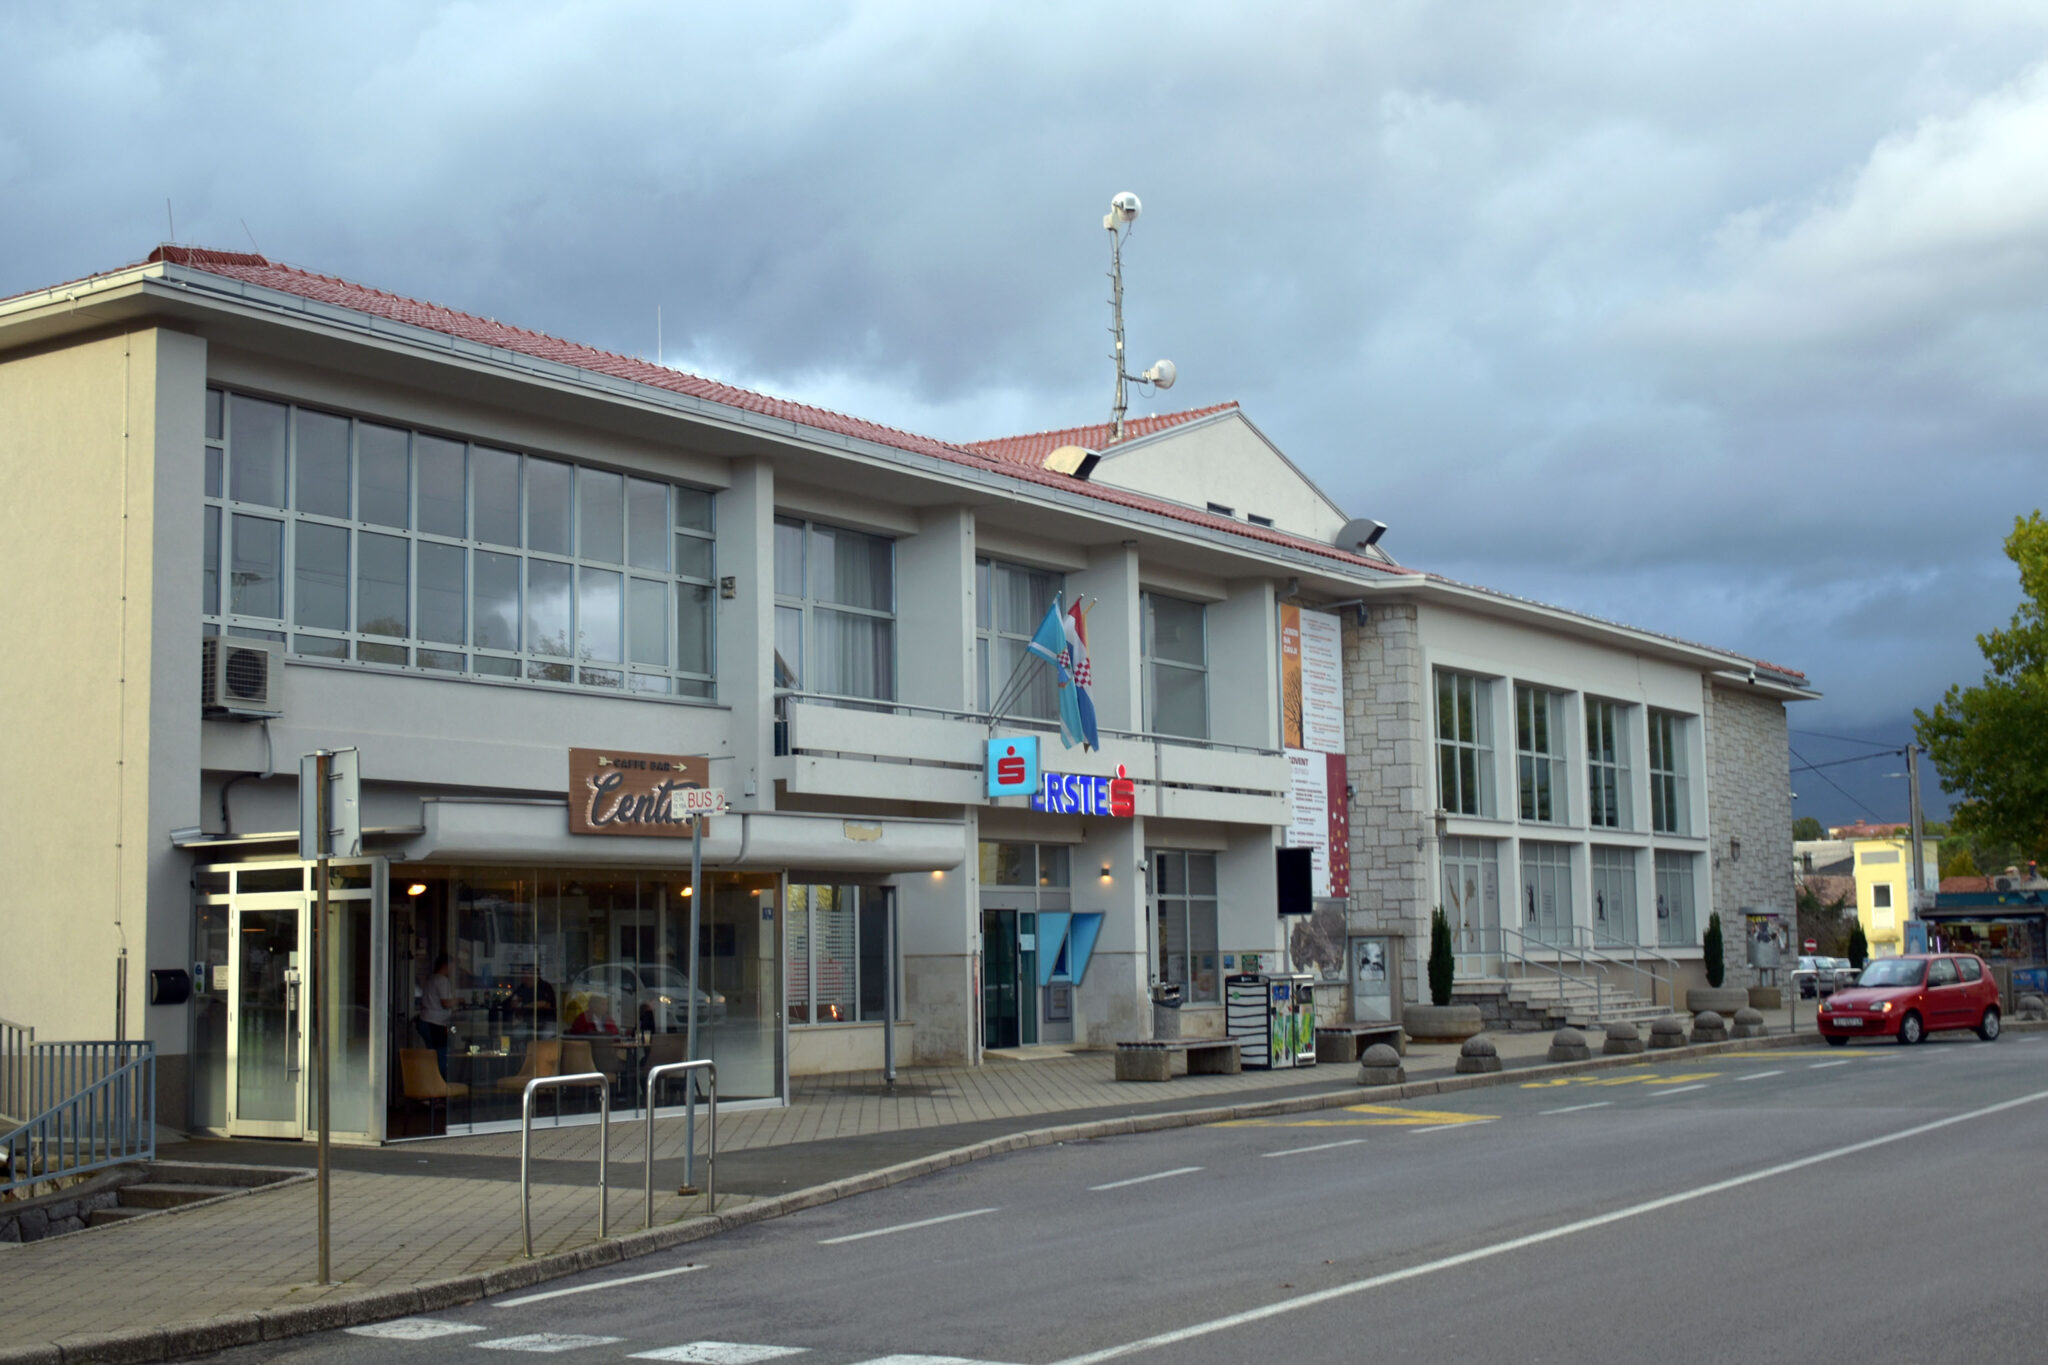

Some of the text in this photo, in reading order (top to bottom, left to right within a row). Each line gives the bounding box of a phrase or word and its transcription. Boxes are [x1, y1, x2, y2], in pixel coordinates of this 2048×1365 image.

[614, 759, 671, 771] CAFFE BAR
[688, 791, 713, 809] BUS
[716, 794, 724, 811] 2
